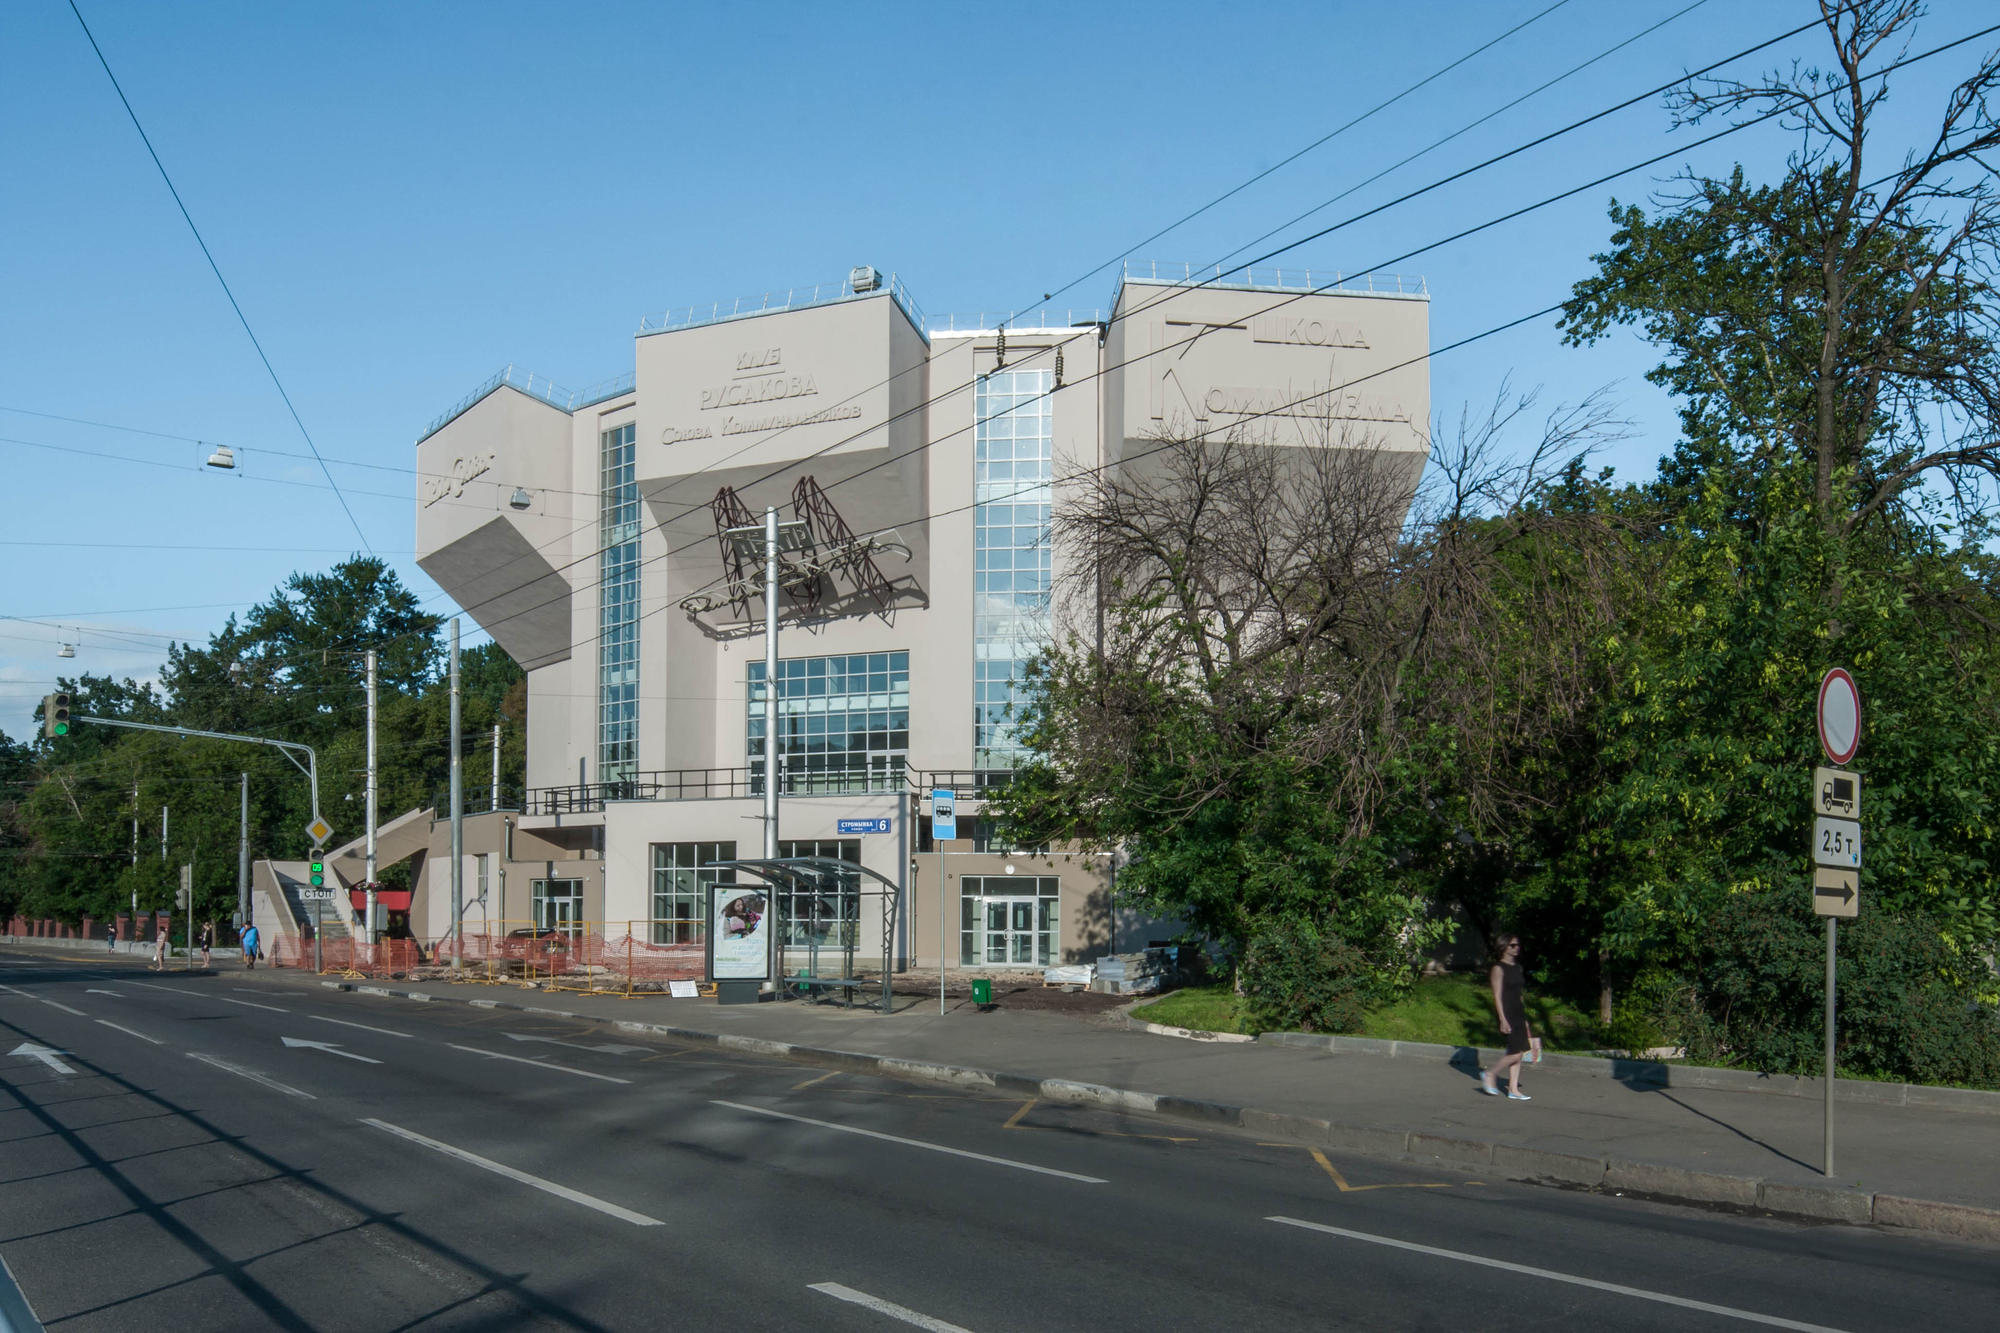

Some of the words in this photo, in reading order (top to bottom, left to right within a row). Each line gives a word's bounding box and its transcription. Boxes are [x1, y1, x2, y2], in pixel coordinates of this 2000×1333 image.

[1253, 316, 1370, 349] ШКОЛА
[736, 347, 781, 370] КЛУБ
[700, 372, 818, 410] РУСАКОВА
[879, 819, 887, 831] 6
[1823, 830, 1841, 856] 2,5
